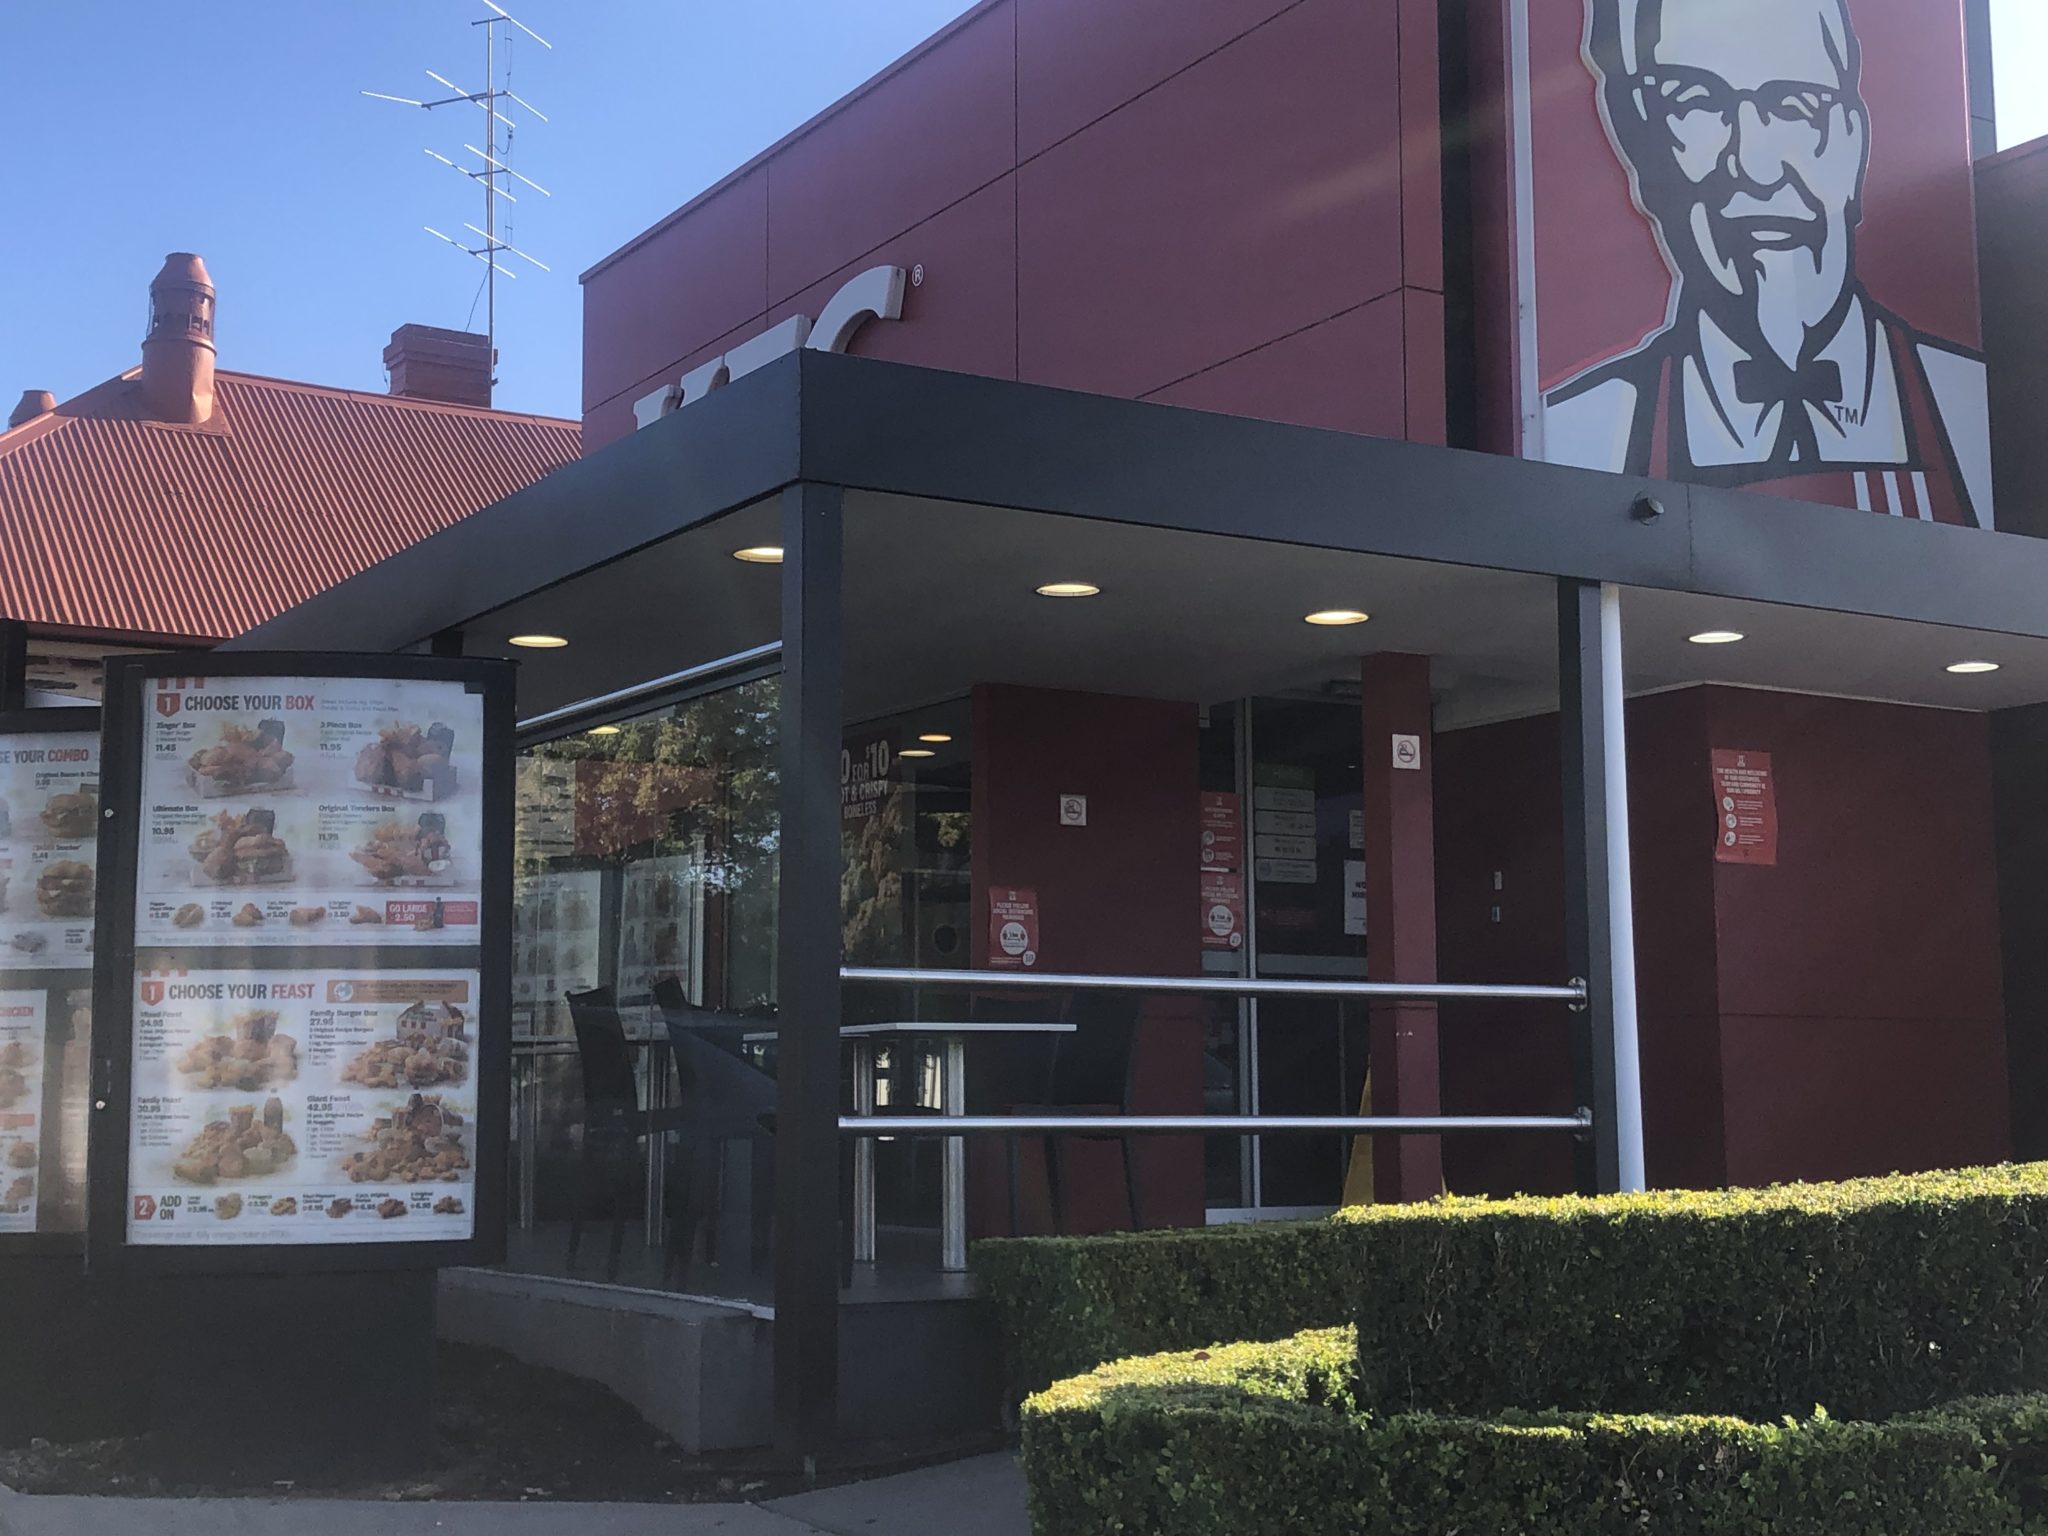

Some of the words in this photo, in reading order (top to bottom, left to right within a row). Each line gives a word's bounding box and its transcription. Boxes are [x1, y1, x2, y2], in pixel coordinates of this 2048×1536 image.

[1834, 405, 1859, 425] TM
[185, 695, 239, 711] CHOOSE
[243, 695, 281, 710] YOUR
[285, 695, 314, 710] BOX
[13, 750, 46, 763] YOUR
[48, 748, 89, 762] COMBO
[858, 779, 889, 800] CRISPY
[318, 804, 348, 812] Original
[168, 983, 224, 1000] CHOOSE
[227, 983, 268, 999] YOUR
[271, 983, 316, 999] FEAST
[159, 1195, 182, 1207] ADD
[159, 1208, 174, 1220] ON
